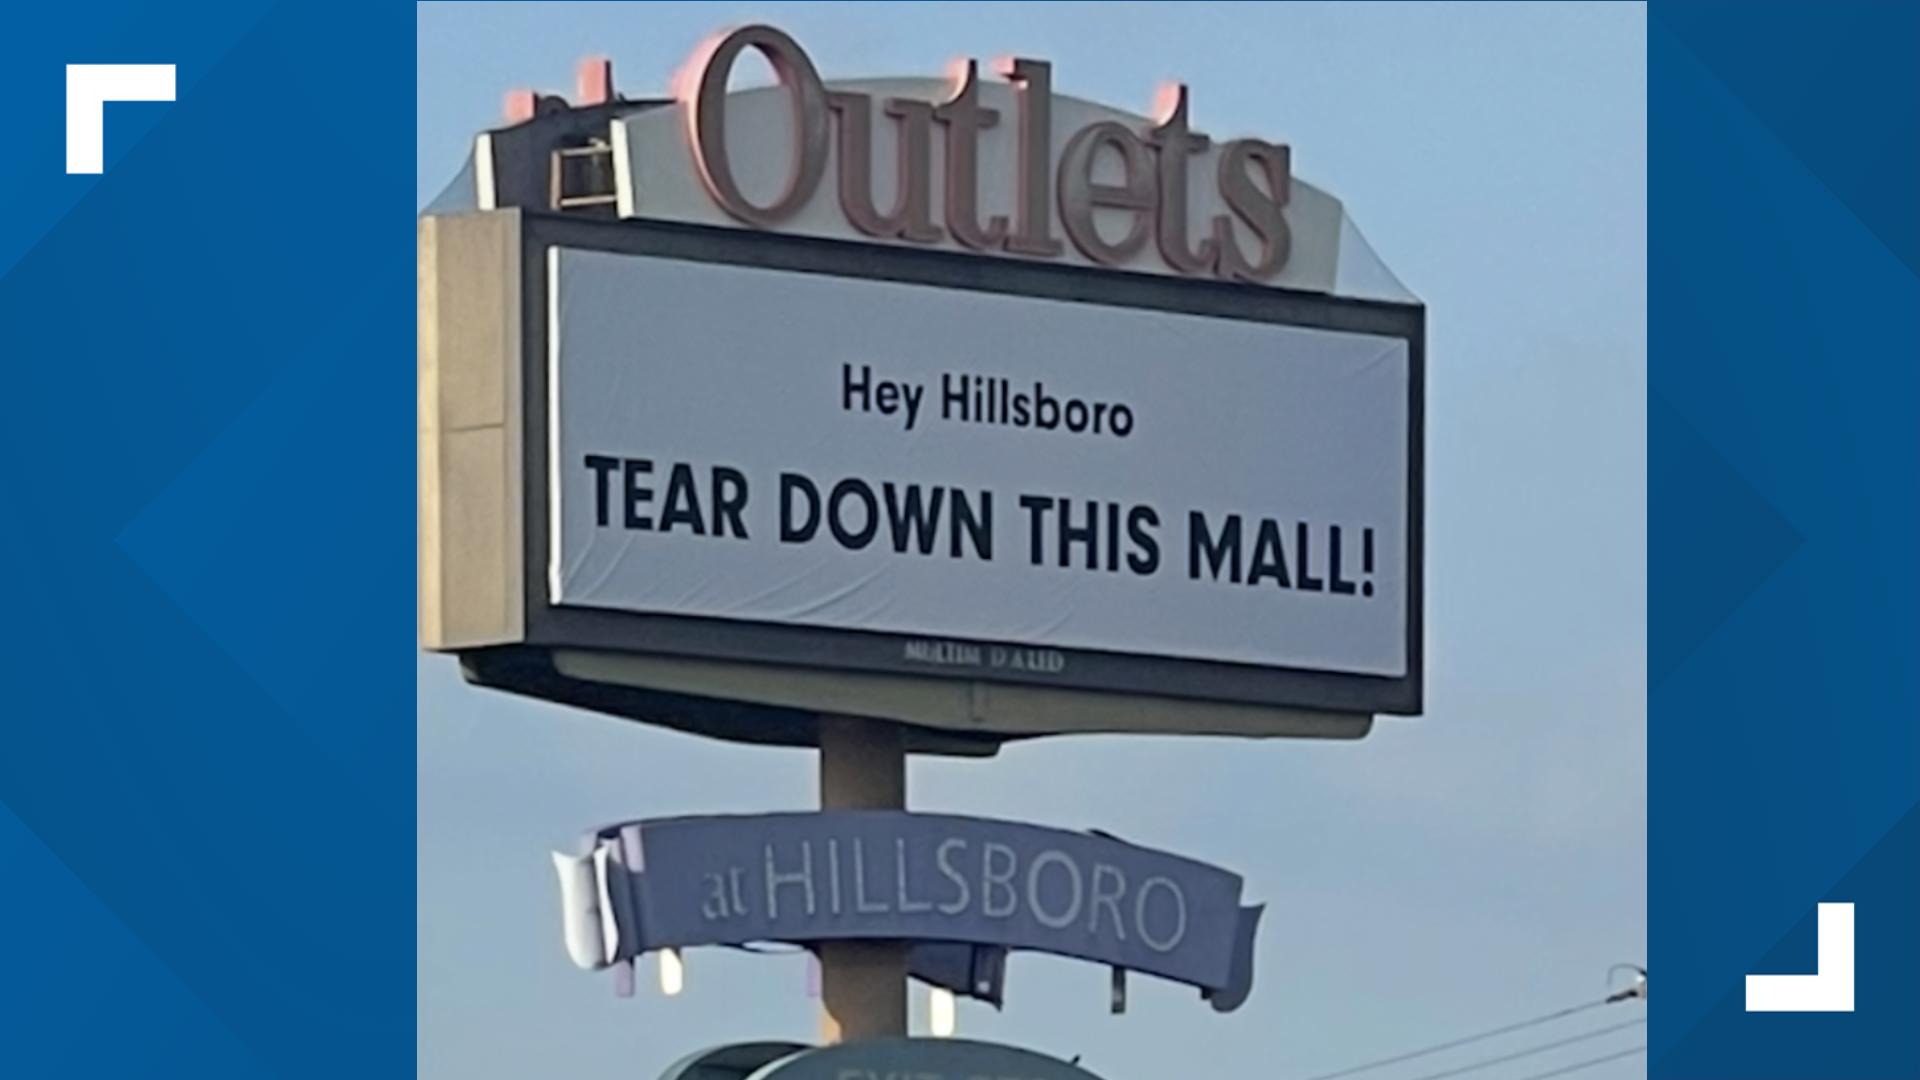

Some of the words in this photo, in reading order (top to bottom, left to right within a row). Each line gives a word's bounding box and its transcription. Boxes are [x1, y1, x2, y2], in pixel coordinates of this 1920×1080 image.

[679, 24, 1292, 283] Outlets
[841, 363, 924, 431] Hey
[941, 373, 1135, 438] Hillsboro
[584, 454, 749, 540] TEAR
[779, 472, 993, 561] DOWN
[1019, 494, 1161, 576] THIS
[1188, 510, 1375, 598] MALL!
[702, 866, 749, 920] at
[766, 837, 1187, 952] HILLSBORO
